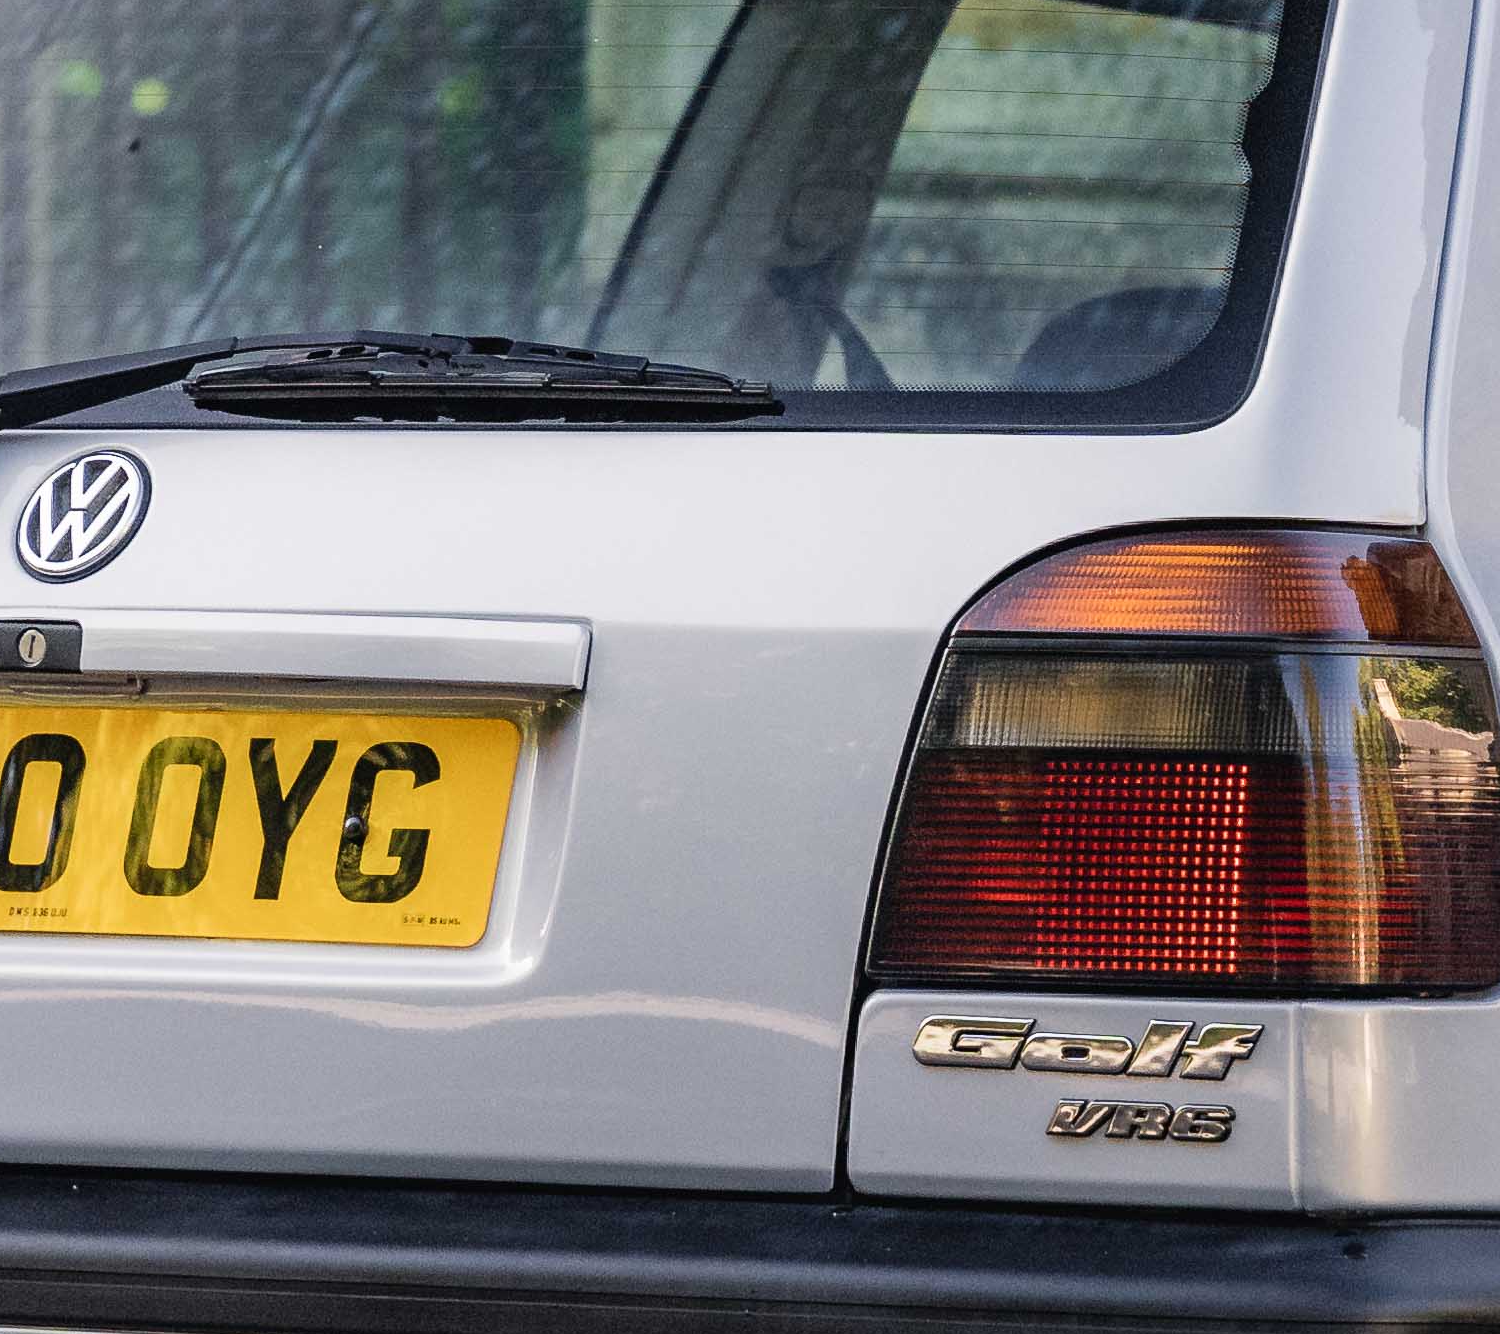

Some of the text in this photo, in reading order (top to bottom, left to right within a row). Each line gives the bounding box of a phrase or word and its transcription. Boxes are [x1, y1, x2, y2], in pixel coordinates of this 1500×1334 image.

[123, 736, 441, 903] OYG
[911, 1013, 1266, 1081] Golf
[1045, 1097, 1237, 1143] VR6
